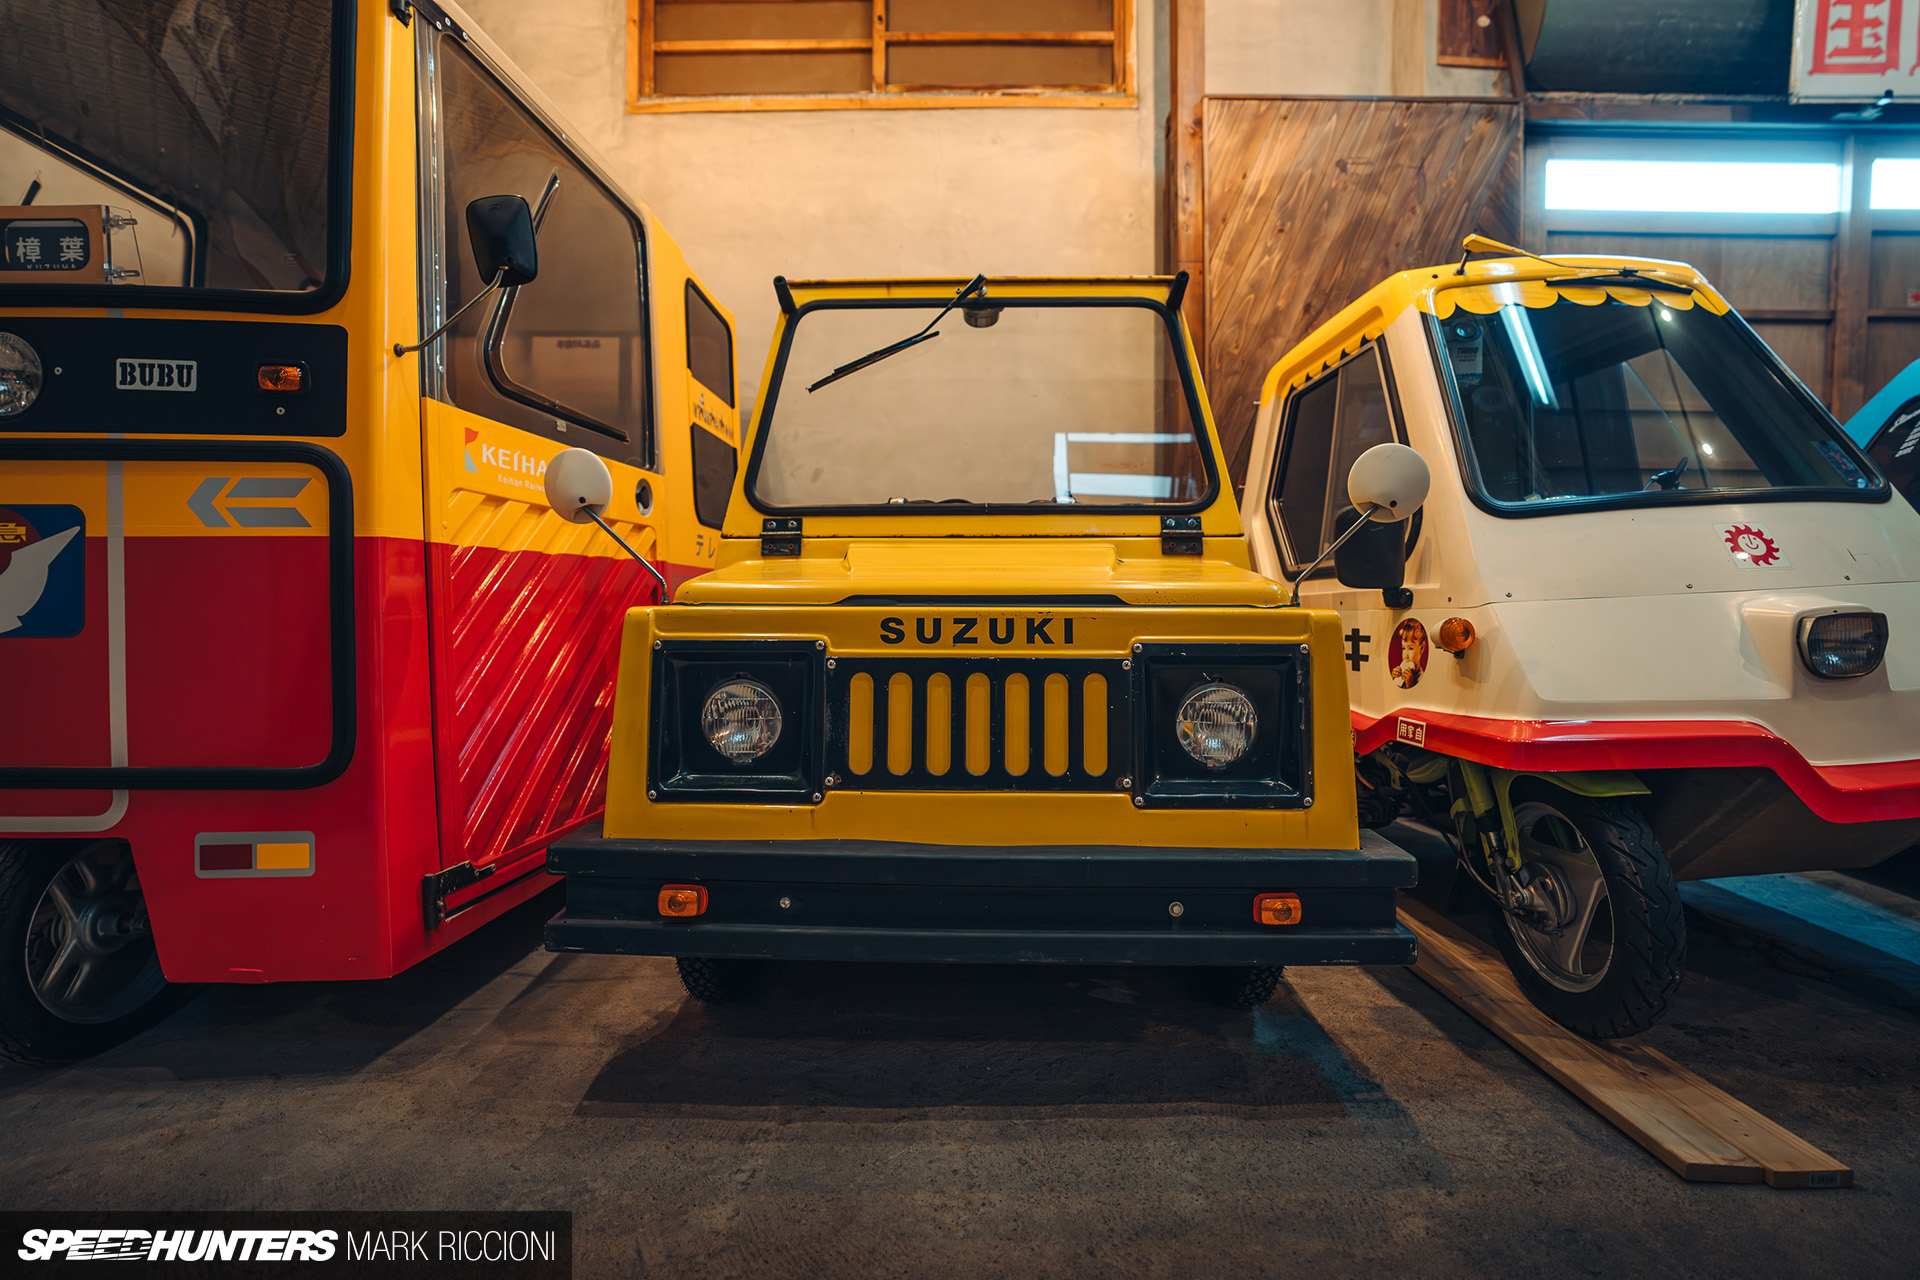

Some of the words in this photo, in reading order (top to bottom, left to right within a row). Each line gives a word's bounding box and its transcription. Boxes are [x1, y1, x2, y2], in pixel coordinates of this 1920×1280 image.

[1808, 0, 1920, 77] 国
[16, 236, 84, 263] 樟葉
[118, 361, 194, 389] BUBU
[481, 443, 546, 477] KEIHA
[498, 473, 523, 487] Keihan
[524, 480, 546, 493] Railw
[696, 534, 716, 559] テレ
[879, 616, 1074, 645] SUZUKI
